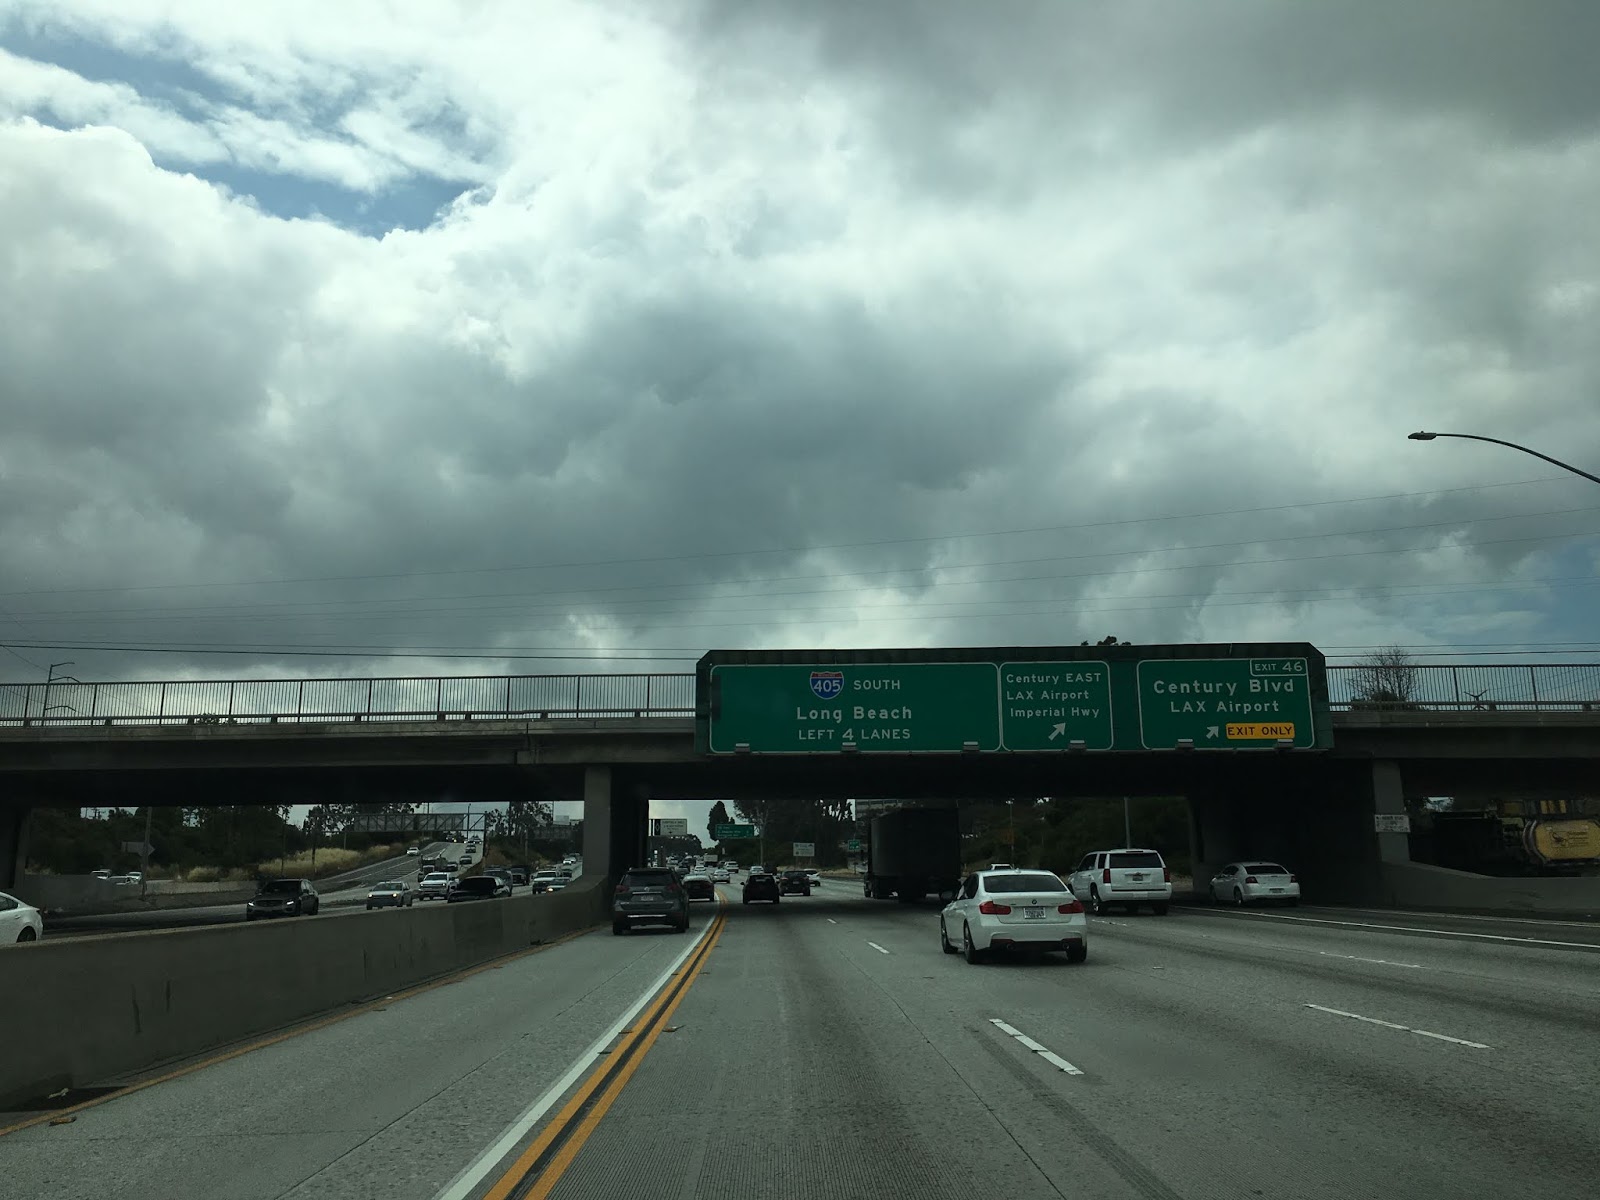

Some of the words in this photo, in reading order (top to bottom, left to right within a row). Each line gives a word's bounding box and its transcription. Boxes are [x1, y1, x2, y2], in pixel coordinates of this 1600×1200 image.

[1254, 663, 1277, 672] EXIT
[1282, 661, 1303, 672] 46
[1006, 674, 1059, 684] Century
[1066, 673, 1101, 682] EAST
[814, 680, 841, 692] 405
[853, 680, 900, 690] SOUTH
[1153, 680, 1237, 696] Century
[1249, 679, 1294, 693] Blvd
[1007, 691, 1034, 700] LAX
[1041, 690, 1089, 701] Airport
[1010, 708, 1065, 718] Imperial
[1071, 707, 1099, 718] Hwy
[1170, 702, 1206, 713] LAX
[1217, 701, 1279, 714] Airport
[797, 707, 842, 723] Long
[853, 706, 912, 719] Beach
[798, 729, 834, 740] LEFT
[842, 728, 854, 740] 4
[861, 729, 911, 740] LANES
[1227, 726, 1257, 736] EXIT
[1261, 726, 1293, 736] ONLY
